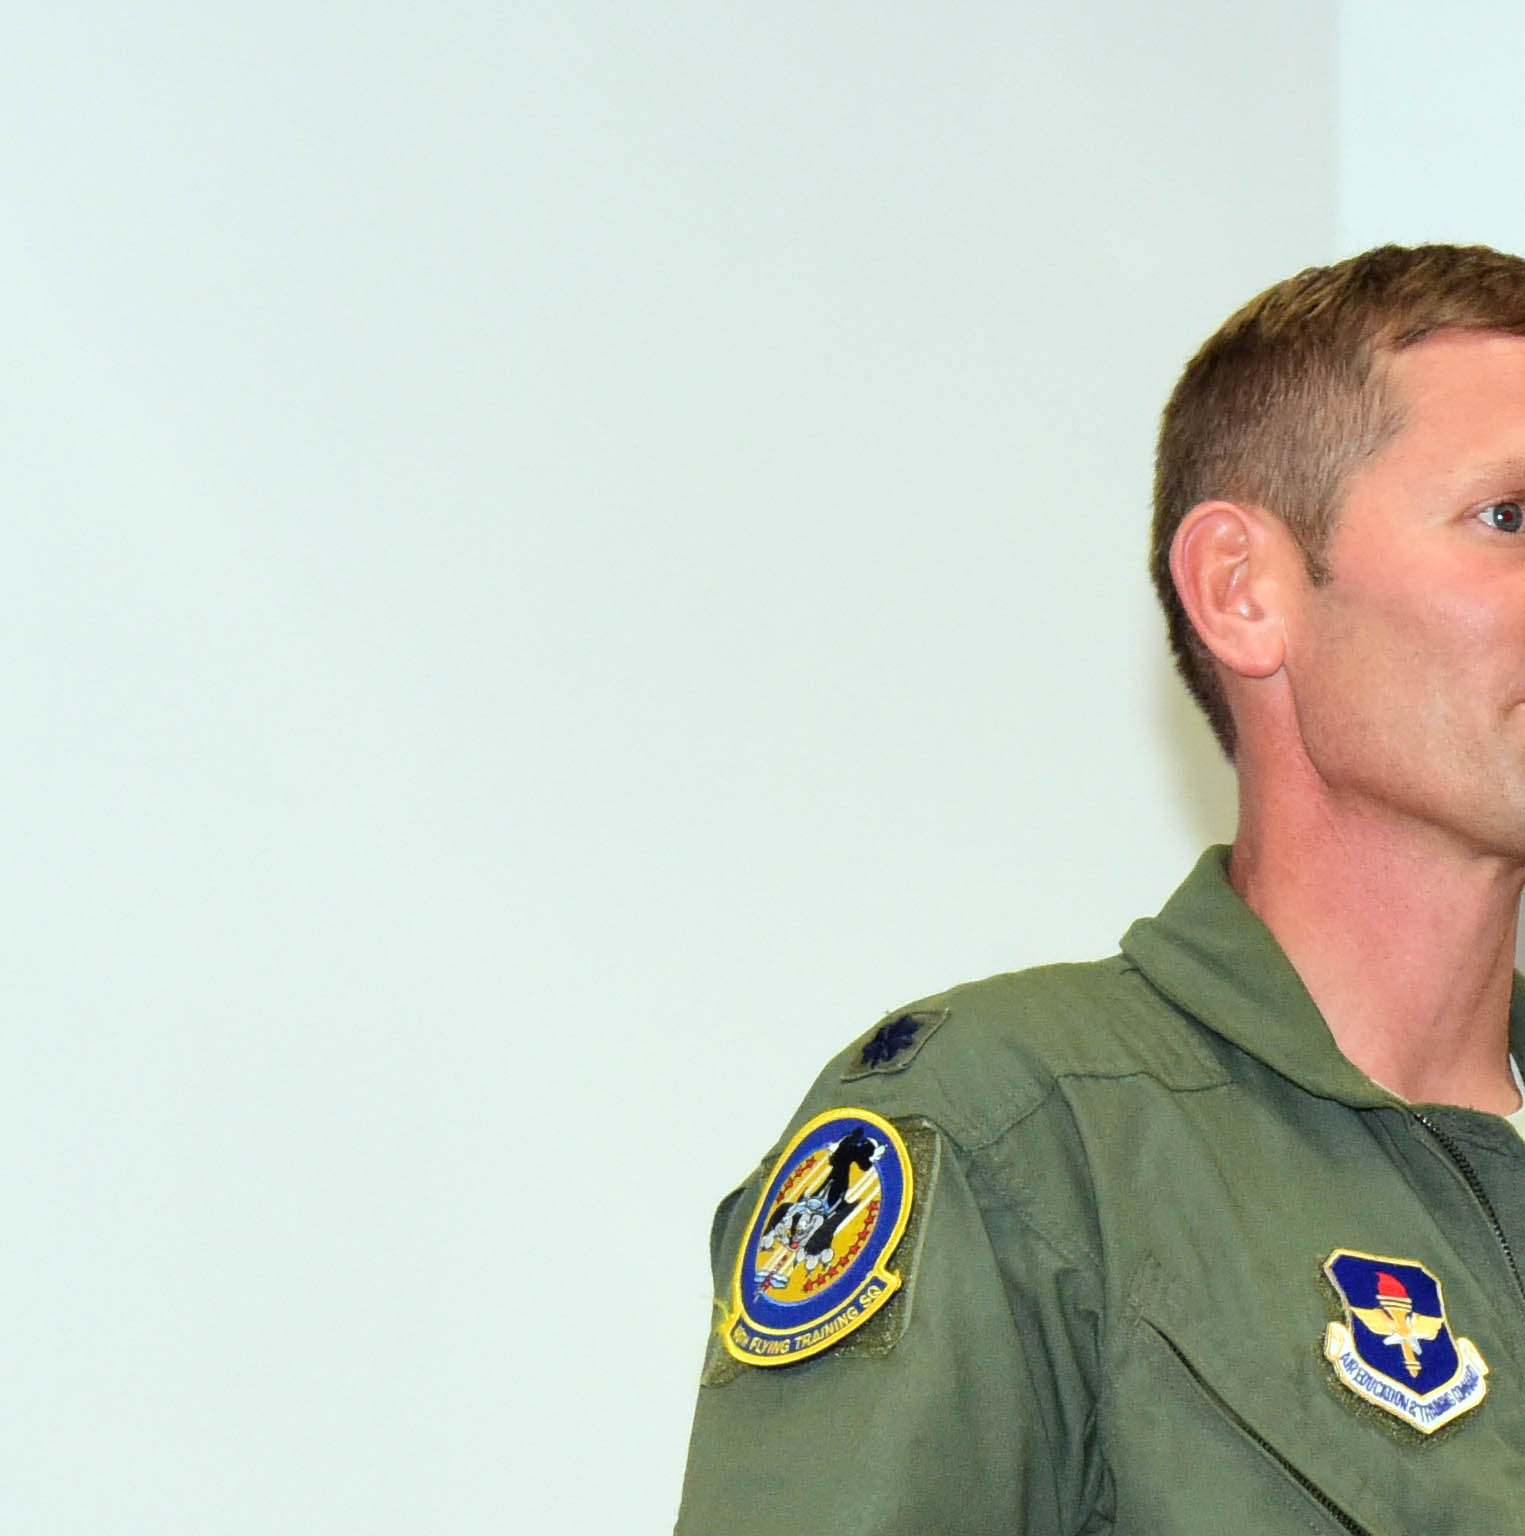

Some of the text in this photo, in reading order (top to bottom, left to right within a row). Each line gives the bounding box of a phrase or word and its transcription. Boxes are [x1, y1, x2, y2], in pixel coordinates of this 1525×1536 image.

[750, 1337, 790, 1354] FLYING
[794, 1307, 858, 1350] TRAINING
[859, 1284, 882, 1308] SQ
